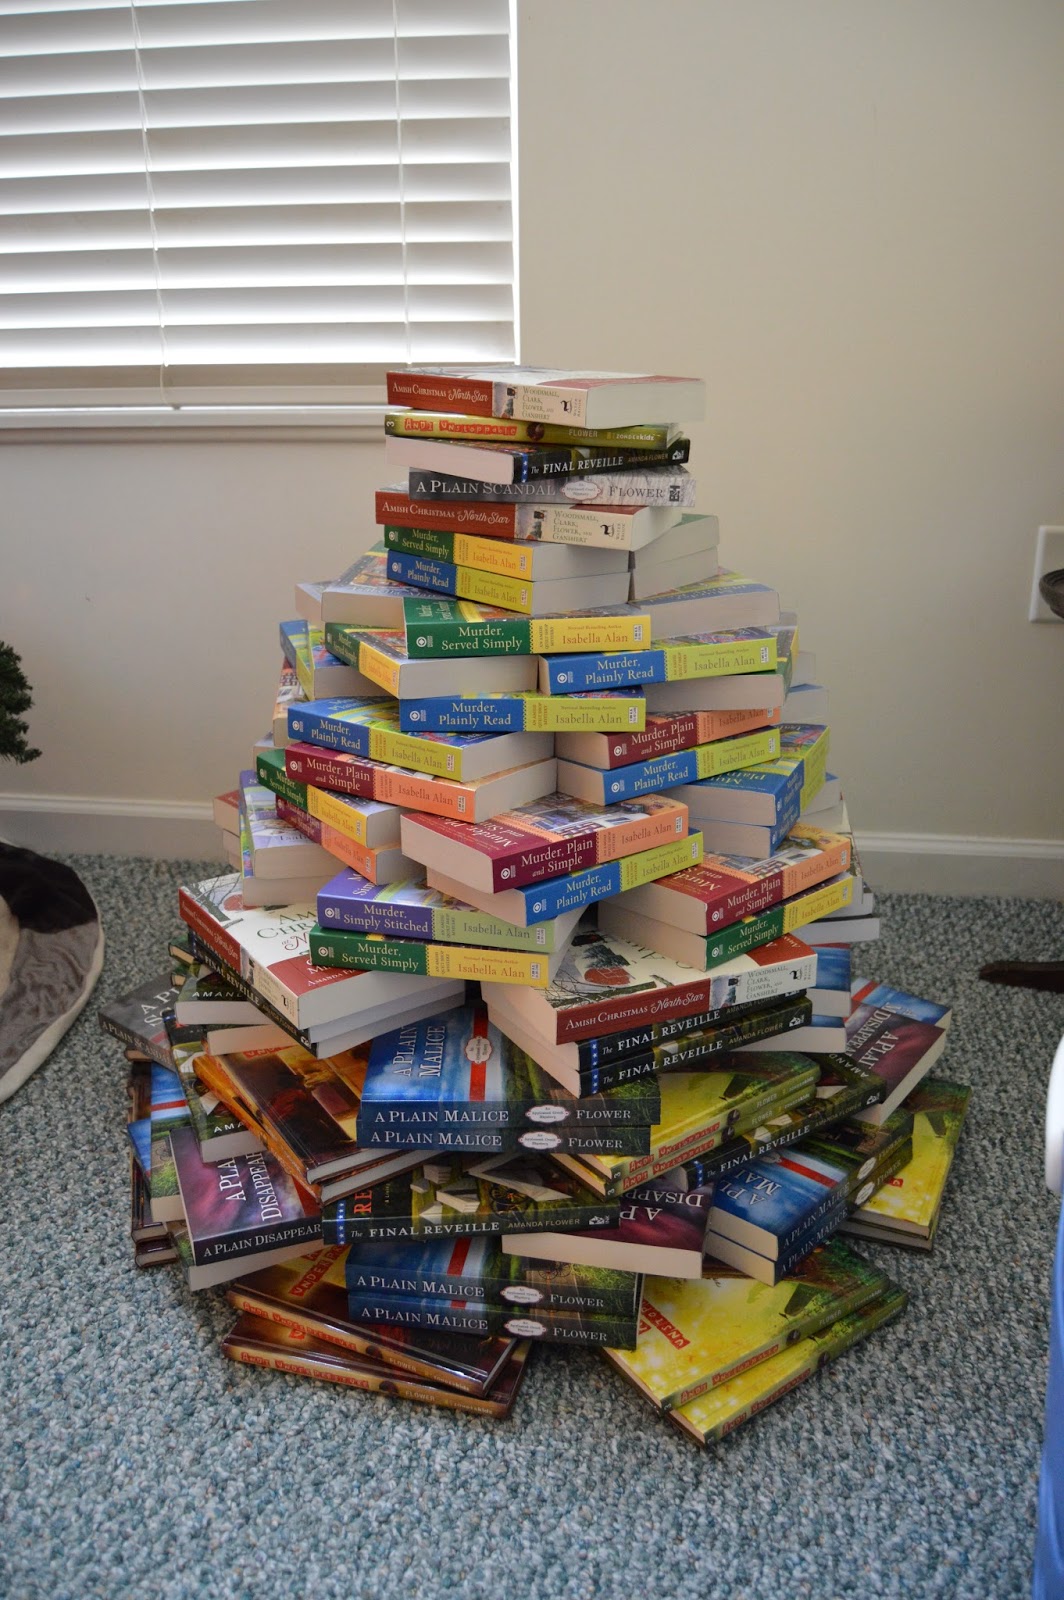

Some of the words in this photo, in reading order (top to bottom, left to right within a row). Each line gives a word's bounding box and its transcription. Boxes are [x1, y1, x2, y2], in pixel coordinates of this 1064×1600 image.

[393, 382, 412, 393] AMISH
[413, 384, 446, 397] CHRISTMAS
[569, 429, 598, 437] FLOWER
[531, 466, 540, 475] The
[542, 461, 575, 474] FINAL
[577, 456, 624, 470] REVEILLE
[649, 453, 668, 461] FLOWER
[416, 482, 426, 492] A
[430, 480, 479, 493] PLAIN
[483, 483, 556, 495] SCANDAL
[609, 486, 664, 498] FLOWER
[382, 502, 409, 514] AMISH
[410, 505, 455, 518] CHRISTMAS
[488, 512, 510, 524] Star
[554, 510, 599, 522] WOODSMALL,
[553, 525, 581, 536] FLOWER,
[554, 518, 578, 527] CLARK,
[412, 529, 439, 543] Murder,
[552, 534, 588, 543] GANSHERT
[402, 538, 425, 551] Served
[425, 542, 449, 559] Simply
[415, 561, 442, 575] Murder,
[473, 552, 498, 567] Isabella
[500, 557, 516, 570] Alan
[407, 570, 430, 585] Plainly
[432, 576, 449, 587] Read
[475, 584, 499, 600] Isabella
[501, 592, 517, 603] Alan
[458, 625, 504, 637] Murder,
[562, 633, 601, 644] Isabella
[604, 633, 628, 643] Alan
[442, 640, 479, 651] Served
[482, 637, 523, 651] Simply
[598, 657, 640, 671] Murder,
[694, 658, 730, 671] Isabella
[734, 657, 755, 666] Alan
[586, 671, 624, 684] Plainly
[628, 666, 654, 679] Read
[451, 702, 498, 714] Murder,
[320, 719, 351, 736] Murder,
[439, 714, 483, 727] Plainly
[486, 714, 511, 725] Read
[555, 713, 594, 724] Isabella
[597, 714, 622, 724] Alan
[311, 731, 339, 747] Plainly
[341, 735, 361, 749] Read
[631, 728, 669, 745] Murder,
[671, 721, 694, 735] Plain
[654, 735, 685, 751] Simple
[392, 748, 421, 764] Isabella
[424, 756, 442, 769] Alan
[719, 754, 747, 767] Isabella
[749, 749, 765, 760] Alan
[307, 758, 343, 776] Murder,
[346, 766, 370, 781] Plain
[643, 760, 677, 777] Murder,
[329, 775, 360, 792] Simple
[634, 775, 664, 790] Plainly
[668, 769, 689, 781] Read
[399, 785, 430, 801] Isabella
[433, 793, 454, 806] Alan
[621, 830, 652, 845] Isabella
[654, 822, 672, 836] Alan
[521, 844, 564, 868] Murder,
[566, 838, 594, 854] Plain
[548, 854, 583, 872] Simple
[642, 860, 670, 878] Isabella
[671, 854, 689, 866] Alan
[801, 863, 823, 880] Isabella
[824, 857, 839, 869] Alan
[566, 874, 602, 892] Murder,
[556, 890, 588, 910] Plainly
[590, 882, 612, 896] Read
[727, 889, 760, 909] Murder,
[761, 878, 781, 892] Plain
[364, 904, 407, 919] Murder,
[747, 892, 773, 914] Simple
[343, 914, 381, 930] Simply
[384, 918, 428, 933] Stitched
[463, 923, 502, 936] Isabella
[506, 926, 531, 939] Alan
[739, 918, 769, 937] Murder,
[728, 936, 753, 954] Served
[753, 924, 779, 947] Simply
[357, 943, 401, 957] Murder,
[341, 953, 377, 966] Served
[381, 956, 419, 972] Simply
[458, 963, 497, 977] Isabella
[500, 967, 525, 979] Alan
[565, 1016, 597, 1030] AMISH
[597, 1005, 648, 1023] CHRISTMAS
[617, 1031, 658, 1052] FINAL
[662, 1009, 721, 1037] REVEILLE
[418, 1026, 447, 1078] MALICE
[604, 1076, 614, 1084] The
[618, 1061, 660, 1081] FINAL
[663, 1040, 723, 1066] REVEILLE
[729, 1031, 756, 1045] AMANDA
[757, 1022, 784, 1037] FLOWER
[392, 1065, 412, 1077] A
[757, 1093, 777, 1108] FLOWER
[375, 1111, 385, 1123] A
[389, 1111, 439, 1123] PLAIN
[444, 1110, 509, 1123] MALICE
[576, 1109, 632, 1120] FLOWER
[752, 1111, 773, 1125] FLOWER
[371, 1132, 381, 1143] A
[384, 1131, 433, 1145] PLAIN
[438, 1132, 503, 1147] MALICE
[568, 1137, 623, 1149] FLOWER
[720, 1153, 755, 1172] FINAL
[759, 1125, 810, 1154] REVEILLE
[226, 1190, 246, 1201] A
[791, 1210, 817, 1239] PLAIN
[818, 1182, 850, 1215] MALICE
[351, 1230, 363, 1238] The
[369, 1224, 419, 1238] FINAL
[424, 1221, 500, 1235] REVEILLE
[507, 1220, 543, 1229] AMANDA
[545, 1218, 580, 1226] FLOWER
[204, 1248, 212, 1257] A
[214, 1239, 252, 1255] PLAIN
[256, 1224, 321, 1246] DISAPPEAR
[788, 1238, 815, 1268] PLAIN
[816, 1209, 848, 1239] MALICE
[357, 1275, 367, 1286] A
[370, 1276, 417, 1290] PLAIN
[422, 1281, 485, 1297] MALICE
[550, 1293, 604, 1308] FLOWER
[362, 1308, 371, 1318] A
[374, 1308, 421, 1322] PLAIN
[427, 1313, 488, 1330] MALICE
[553, 1327, 608, 1342] FLOWER
[405, 1391, 435, 1401] FLOWER
